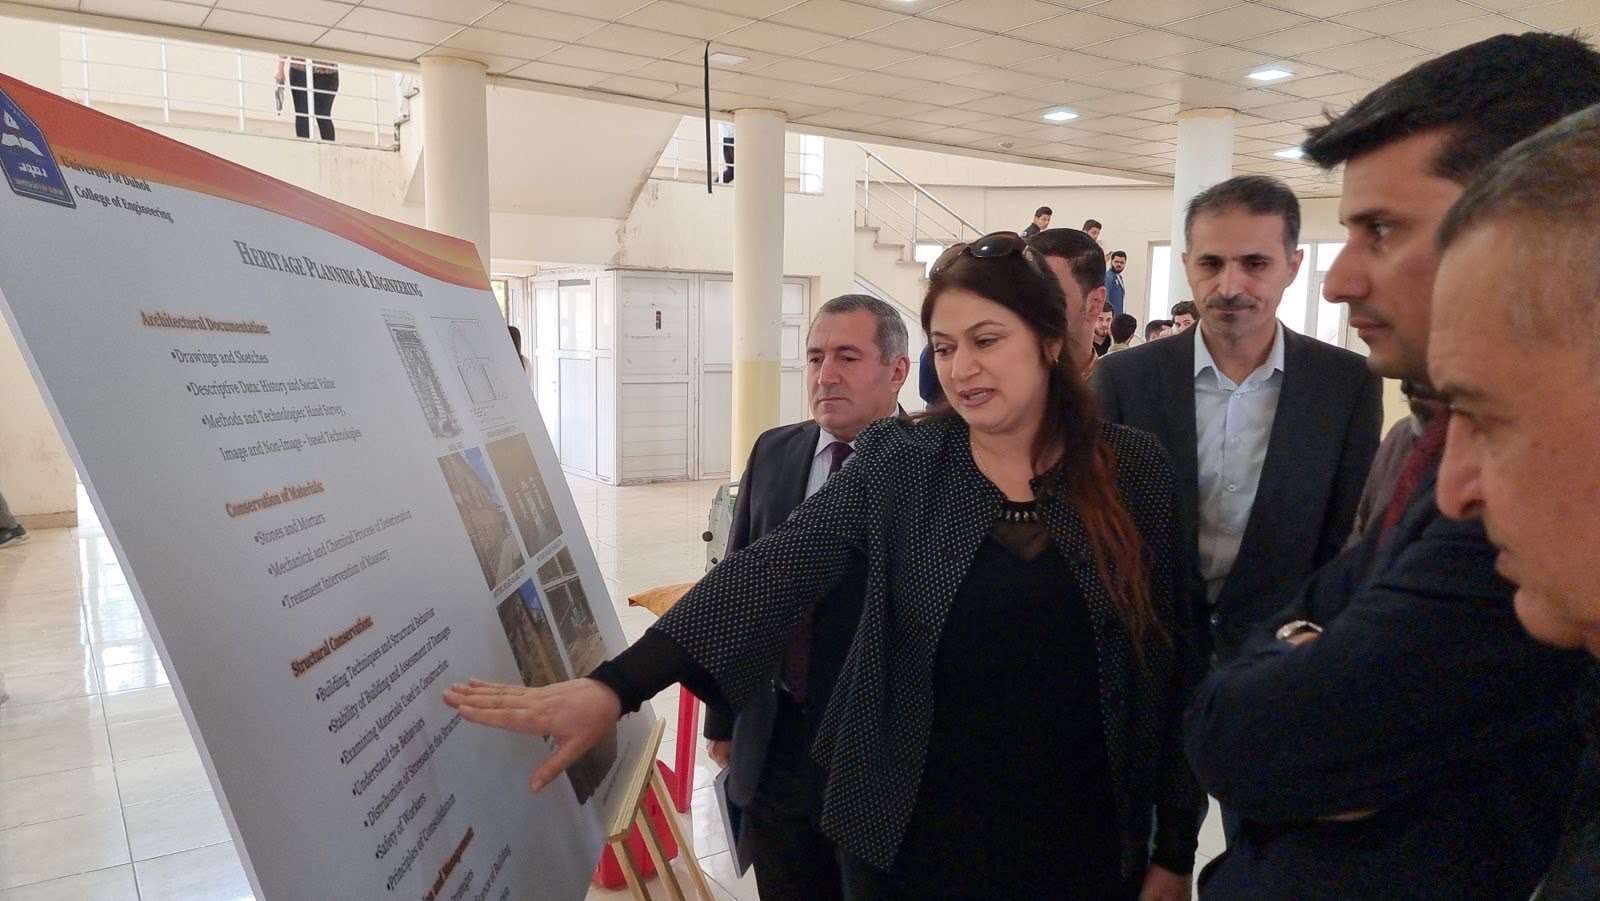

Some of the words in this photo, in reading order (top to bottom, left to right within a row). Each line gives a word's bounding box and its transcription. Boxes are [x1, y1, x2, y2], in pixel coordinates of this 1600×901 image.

[60, 155, 112, 183] University
[112, 171, 123, 184] of
[122, 174, 152, 192] Duhok
[74, 185, 112, 208] College
[111, 195, 123, 209] of
[121, 199, 175, 224] Engineering
[233, 240, 306, 276] HERITAGE
[356, 268, 369, 288] &
[140, 311, 207, 330] Architectural
[173, 349, 219, 367] Drawings
[218, 350, 236, 363] and
[235, 350, 270, 364] Sketches
[189, 381, 240, 399] Descriptive
[259, 380, 288, 396] History
[287, 379, 302, 391] and
[204, 411, 243, 429] Methods
[243, 409, 260, 424] and
[219, 447, 248, 462] Image
[247, 441, 262, 456] and
[225, 492, 281, 518] Conservation
[280, 487, 290, 502] of
[257, 530, 285, 545] Stones
[284, 523, 298, 537] and
[270, 547, 314, 576] Mechanical
[313, 541, 327, 558] and
[284, 581, 323, 608] Treatment
[291, 638, 331, 677] Structural
[318, 674, 350, 701] Building
[380, 636, 393, 654] and
[330, 703, 360, 734] Stability
[357, 692, 367, 710] of
[389, 664, 402, 683] and
[343, 726, 380, 765] Examining
[375, 701, 405, 731] Materials
[354, 749, 392, 796] Understand
[377, 829, 399, 859] Safety
